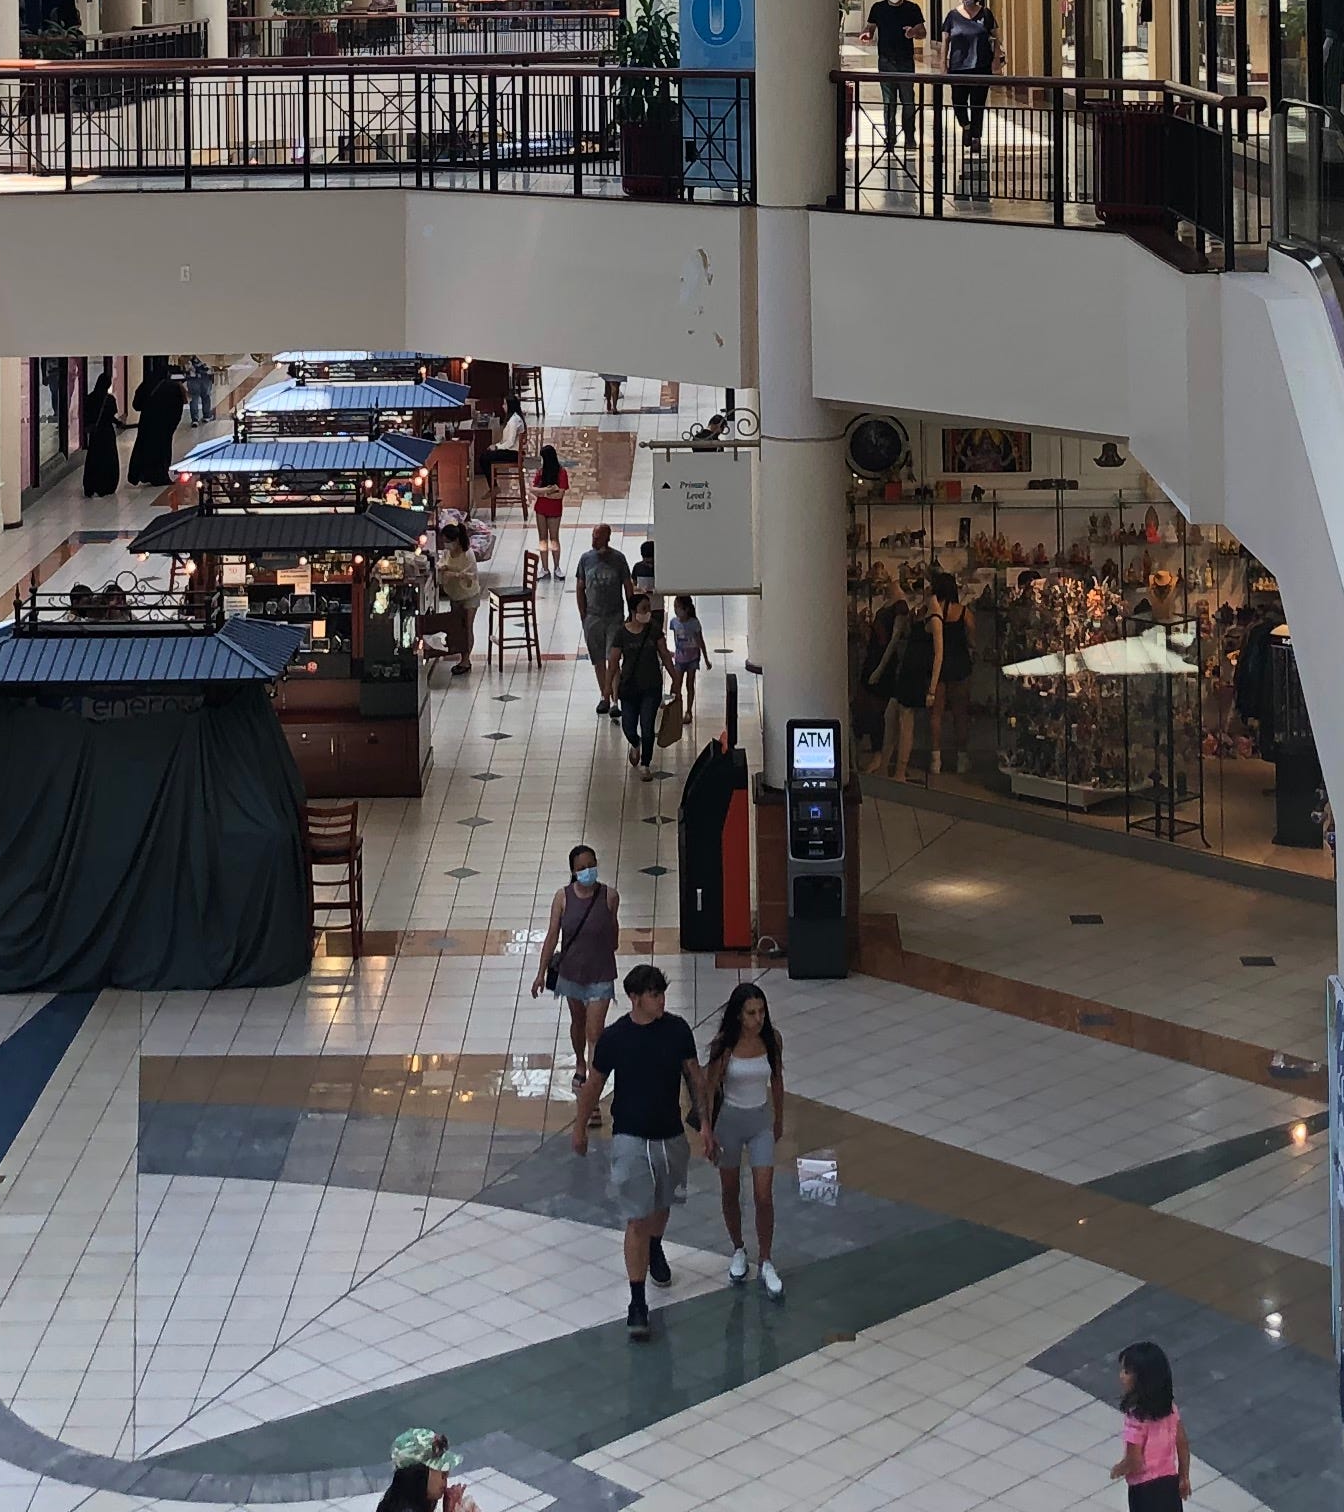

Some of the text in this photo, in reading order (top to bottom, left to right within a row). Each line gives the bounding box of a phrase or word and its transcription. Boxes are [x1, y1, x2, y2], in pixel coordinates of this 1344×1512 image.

[686, 492, 704, 500] Level
[686, 502, 712, 510] Level 3
[797, 732, 831, 748] ATM
